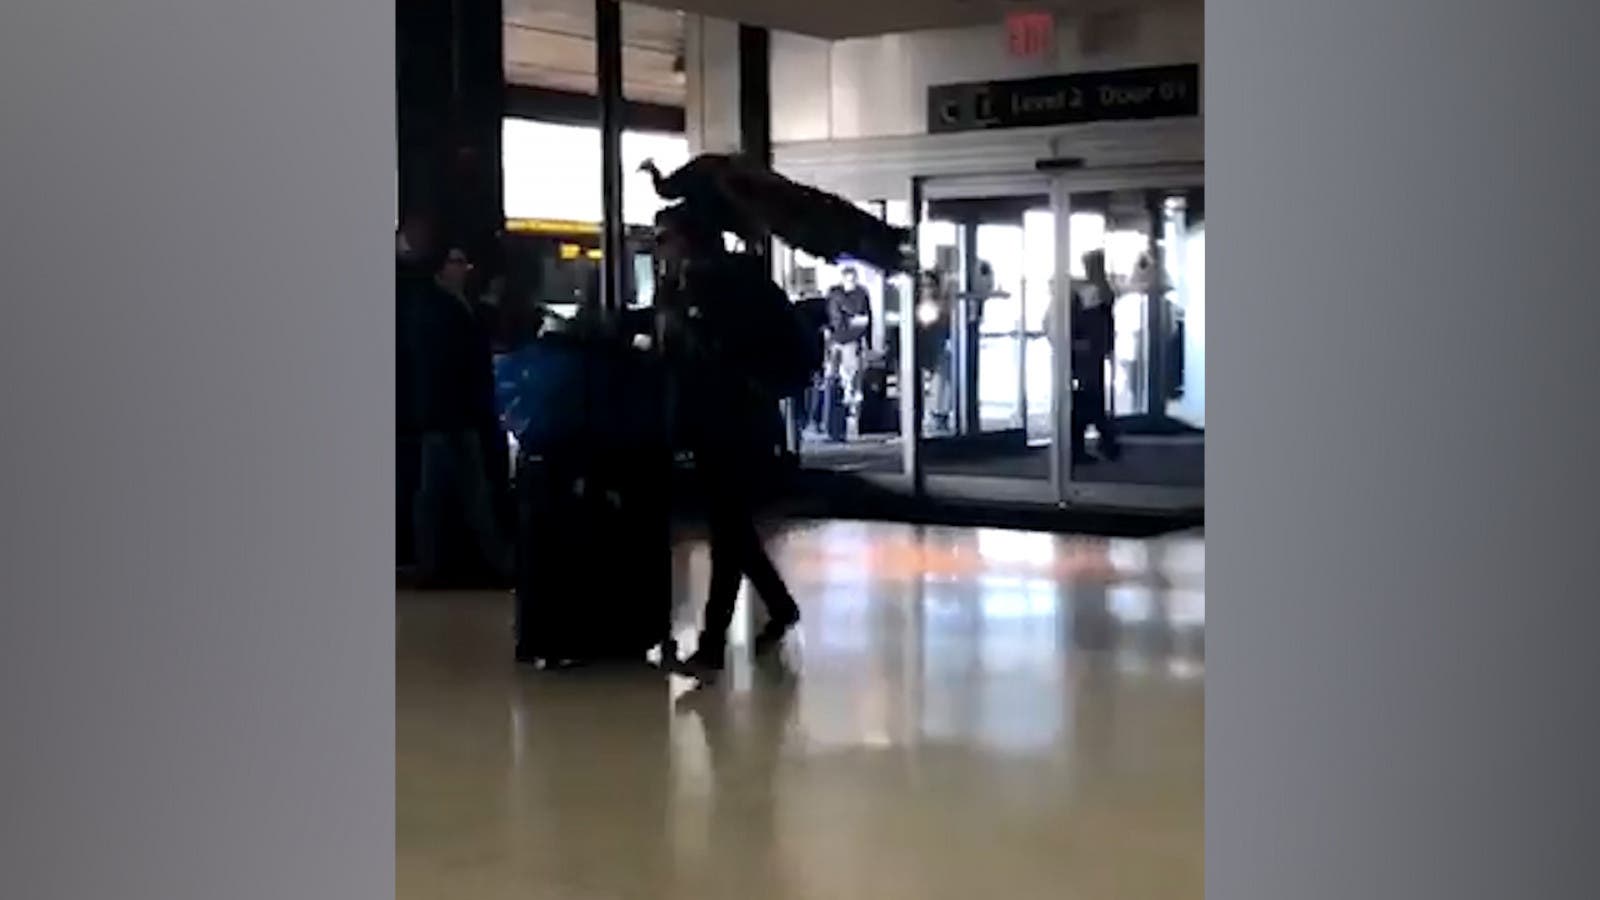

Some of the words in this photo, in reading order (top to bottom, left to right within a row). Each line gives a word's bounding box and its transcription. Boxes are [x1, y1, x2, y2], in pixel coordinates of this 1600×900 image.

[1011, 91, 1064, 115] Level
[1067, 88, 1083, 108] 2
[1099, 84, 1153, 106] Door
